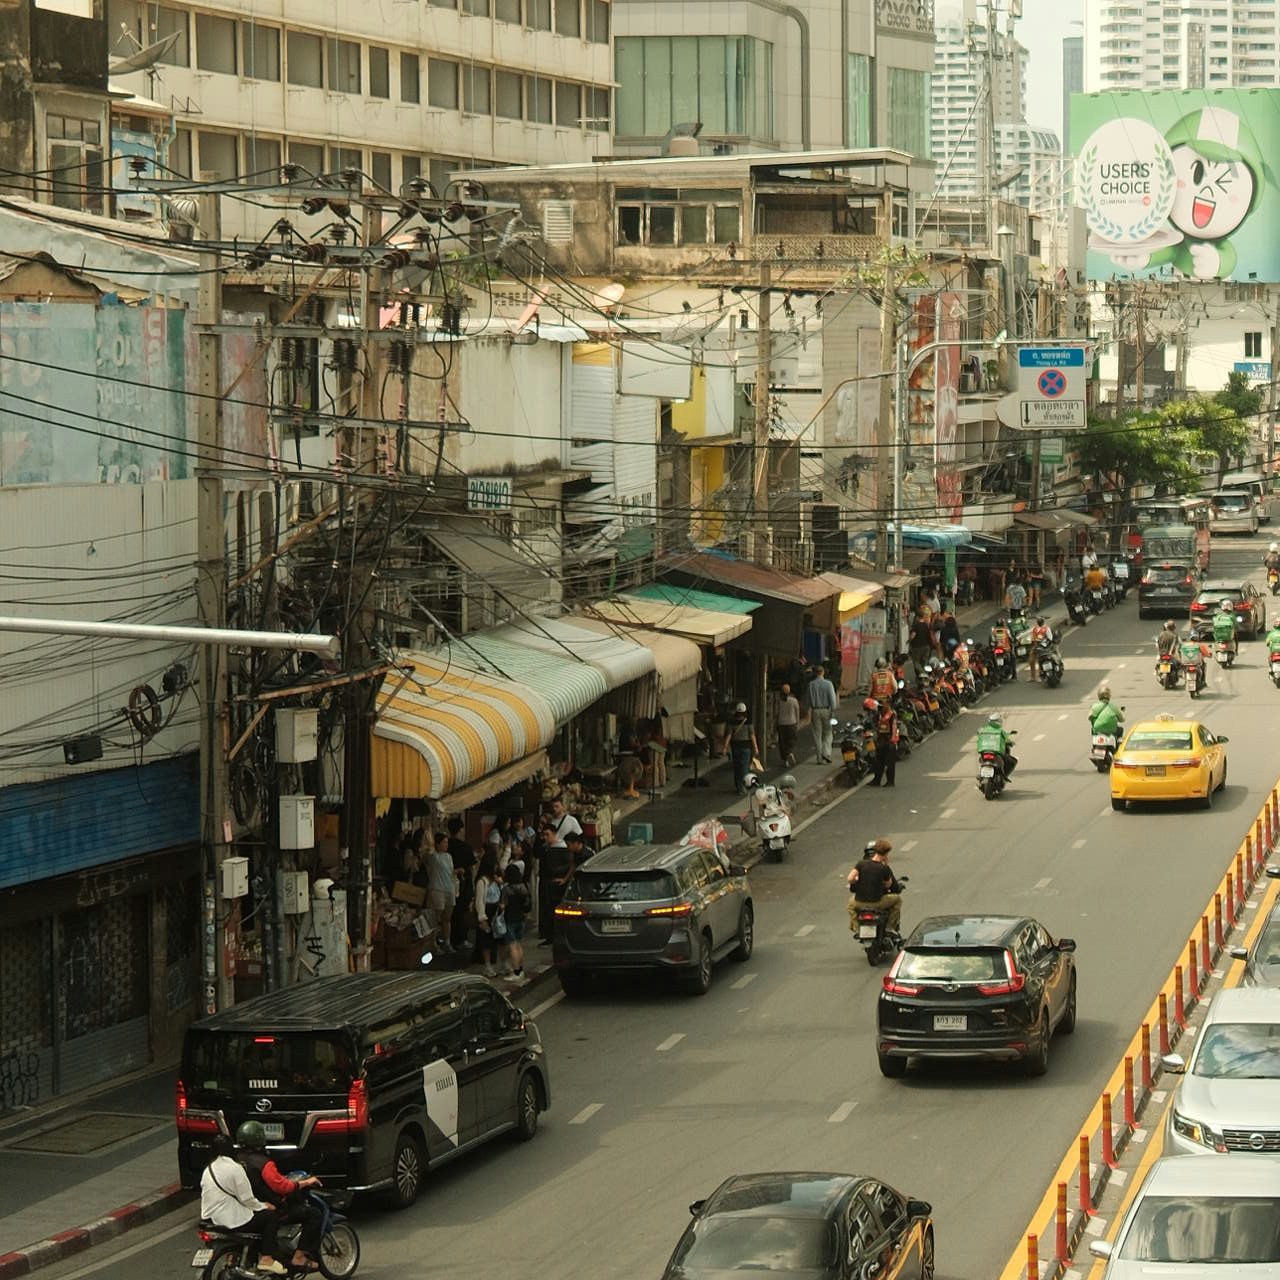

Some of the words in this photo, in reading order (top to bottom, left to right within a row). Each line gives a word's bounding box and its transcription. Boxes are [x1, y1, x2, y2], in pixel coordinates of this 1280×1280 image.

[1101, 182, 1150, 194] CHOICE
[1034, 402, 1079, 411] ตลอดเวลา
[249, 1079, 278, 1088] muu
